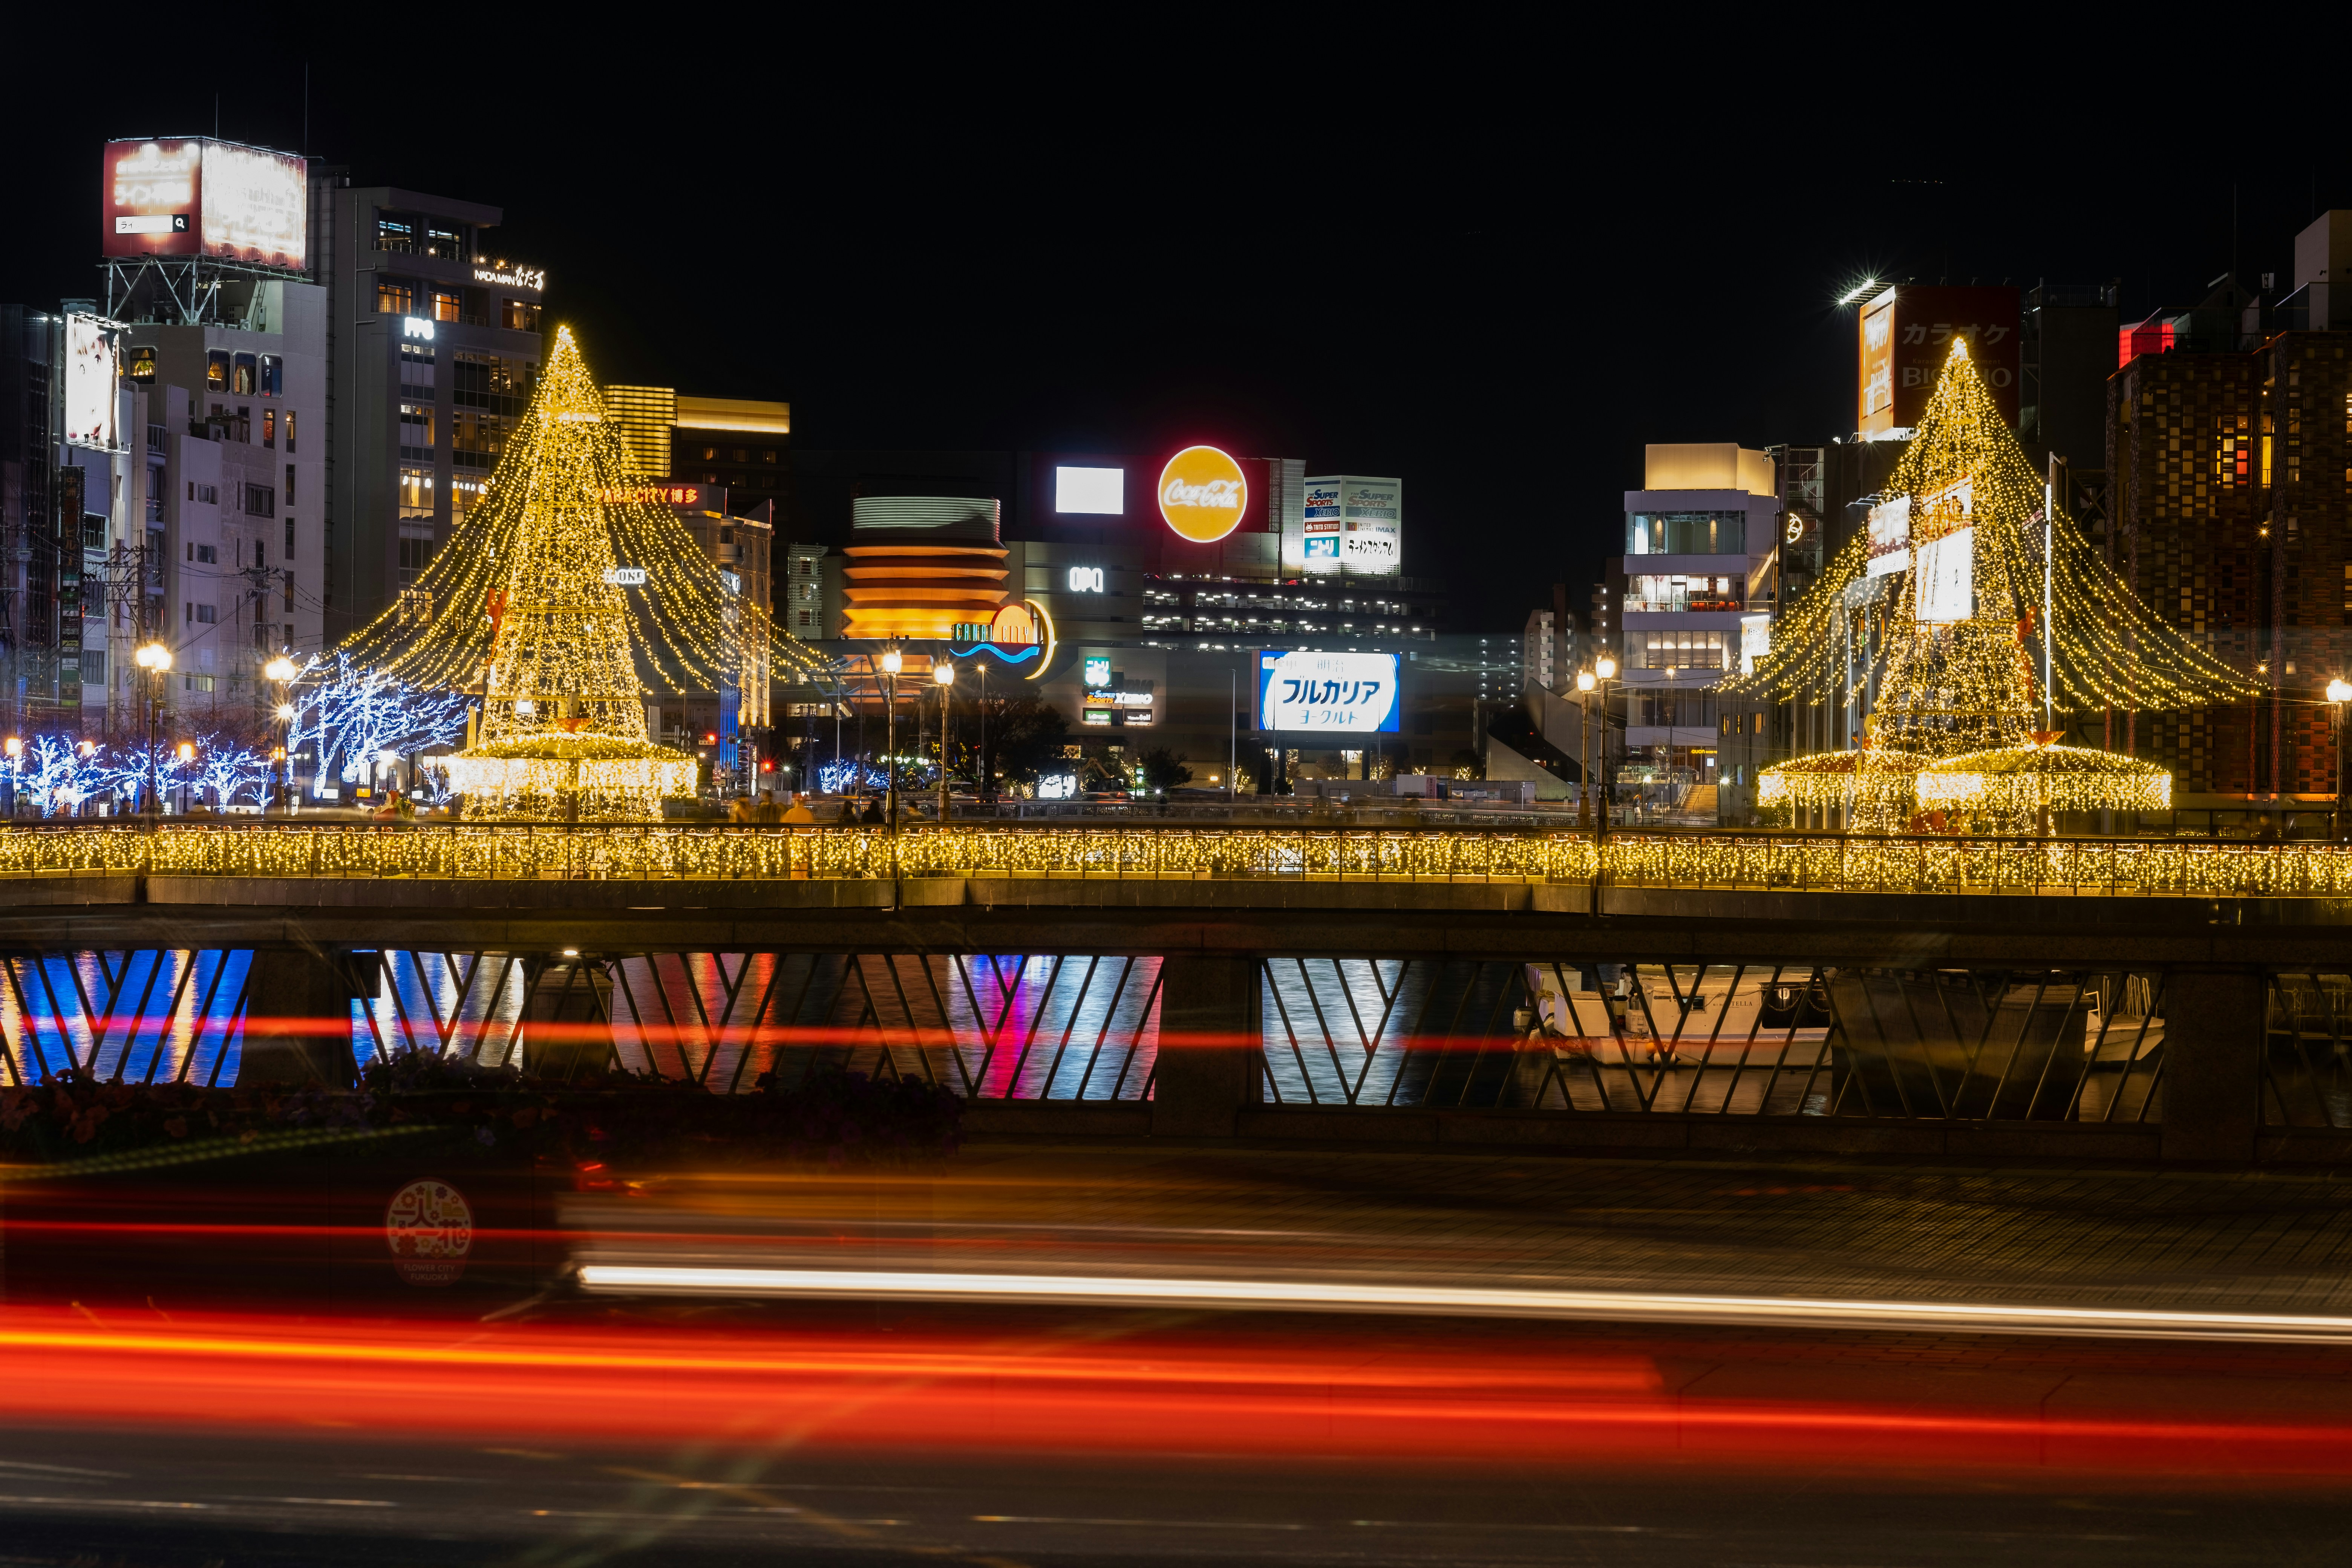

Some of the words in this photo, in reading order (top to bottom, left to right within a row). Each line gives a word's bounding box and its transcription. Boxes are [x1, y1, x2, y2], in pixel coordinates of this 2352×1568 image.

[1902, 323, 2010, 345] カラオケ
[671, 489, 697, 503] 博多
[1164, 478, 1242, 509] Coca-Cola
[1314, 489, 1339, 500] SUPER
[1358, 489, 1394, 501] SUPER
[1305, 496, 1334, 507] SPORTS
[1347, 495, 1387, 507] SPORTS
[1314, 507, 1340, 517] XEBIO
[1359, 508, 1396, 518] XEBIO
[1310, 539, 1334, 556] ニトリ
[954, 623, 994, 642] CANAL
[1002, 625, 1029, 643] CITY
[1265, 656, 1297, 670] meiji
[1317, 658, 1344, 673] 明治
[1094, 690, 1116, 698] SUPER
[1283, 675, 1380, 706] ブルガリア
[1086, 695, 1114, 703] SPORTS
[1114, 692, 1153, 704] XEBIO
